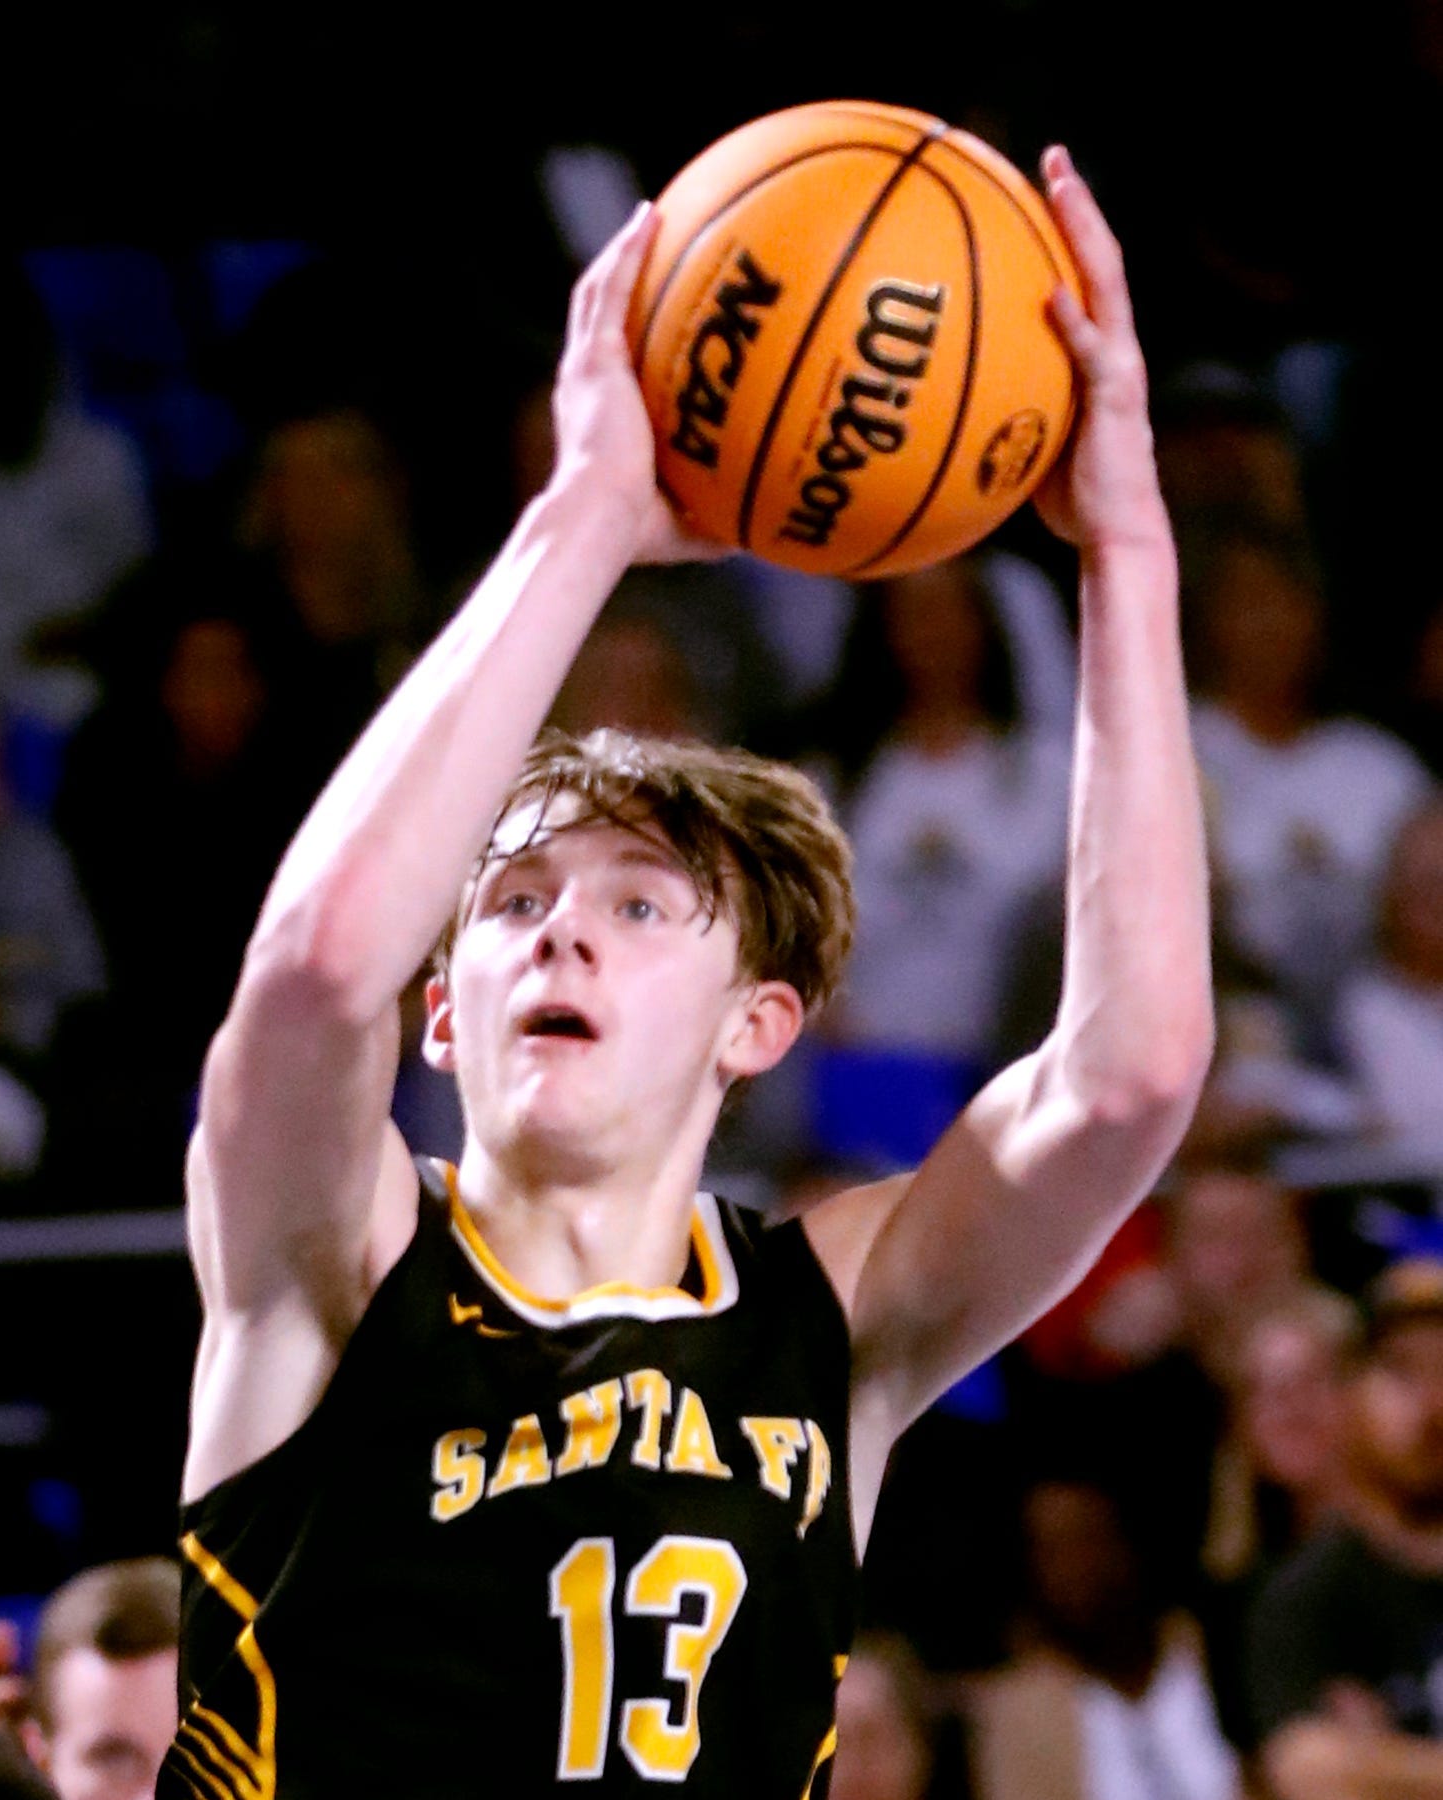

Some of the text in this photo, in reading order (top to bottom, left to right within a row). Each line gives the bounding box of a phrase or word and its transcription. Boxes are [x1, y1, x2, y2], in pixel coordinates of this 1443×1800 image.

[670, 250, 784, 471] NCAA
[777, 277, 948, 548] Wilson
[430, 1367, 733, 1523] SANTA
[548, 1534, 748, 1783] 13
